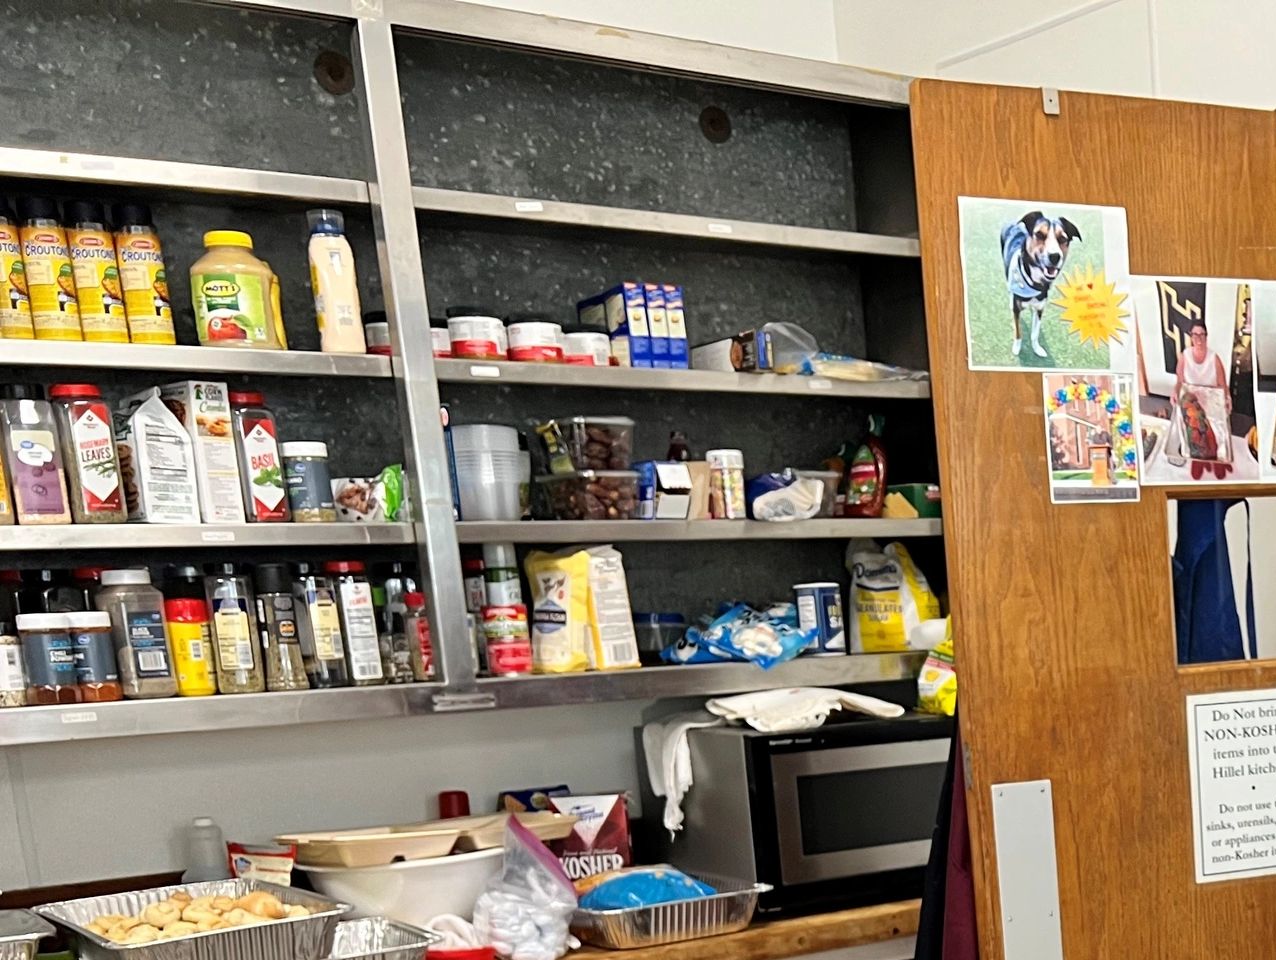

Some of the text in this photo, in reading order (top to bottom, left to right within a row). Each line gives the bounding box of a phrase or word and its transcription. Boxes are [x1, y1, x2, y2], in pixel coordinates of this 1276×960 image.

[81, 446, 111, 462] LEAVES
[1212, 710, 1230, 721] Do
[1233, 708, 1255, 720] Not
[1213, 748, 1244, 760] items
[1248, 745, 1270, 757] into
[1213, 765, 1245, 779] Hillel
[1219, 803, 1234, 814] Do
[1237, 803, 1252, 813] not
[1255, 801, 1272, 810] use
[1206, 820, 1235, 832] sinks,
[1211, 839, 1221, 847] or
[1224, 833, 1276, 848] appliances
[1212, 848, 1269, 863] non-Kosher
[560, 853, 624, 880] KOSHER
